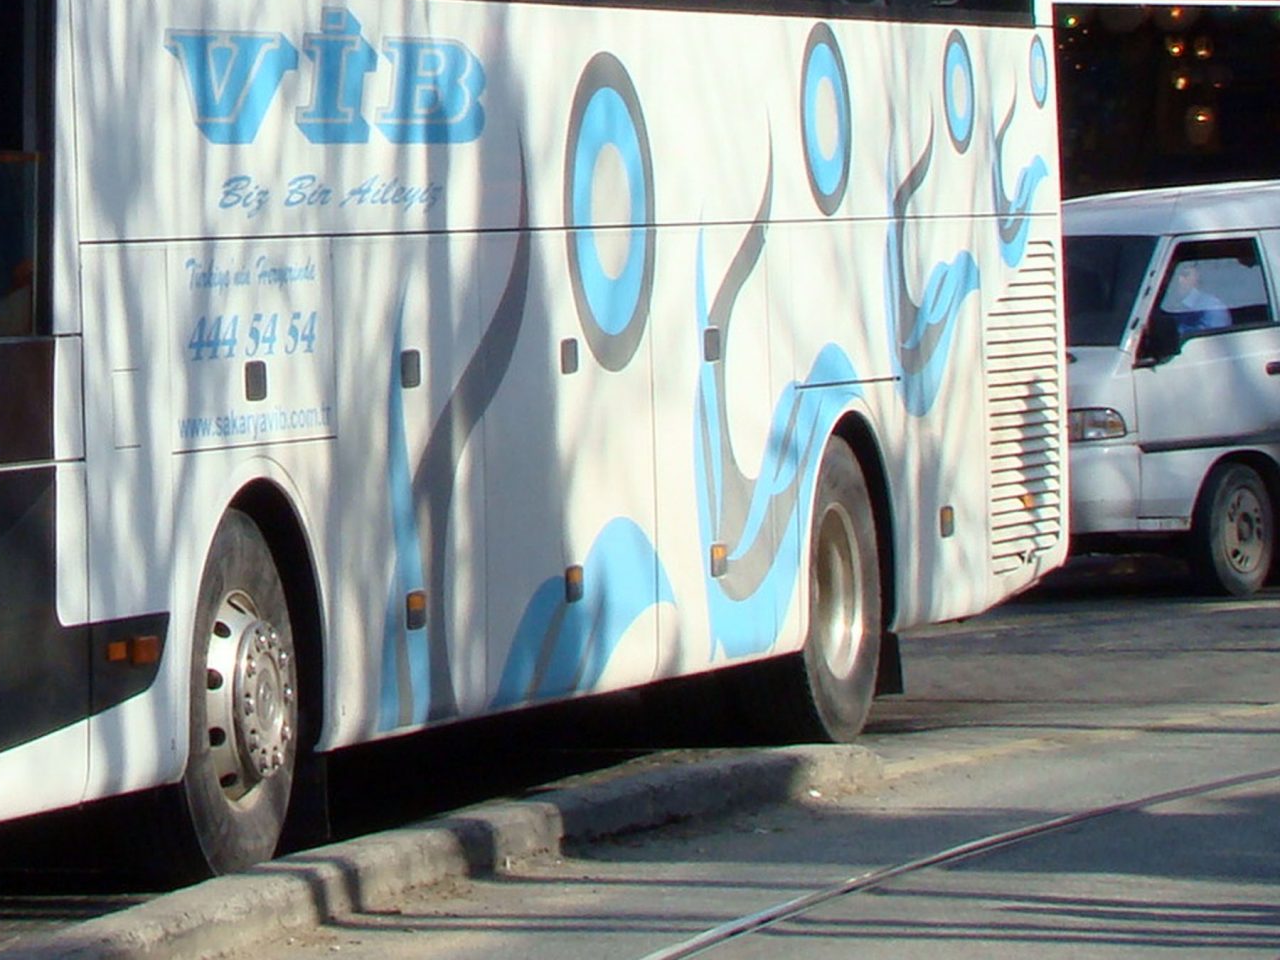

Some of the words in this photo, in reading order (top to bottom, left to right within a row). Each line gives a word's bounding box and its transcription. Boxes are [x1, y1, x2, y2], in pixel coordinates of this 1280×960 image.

[164, 5, 488, 145] VİB
[218, 175, 270, 219] Biz
[283, 174, 332, 208] Bir
[188, 315, 239, 361] 444
[245, 313, 278, 357] 54
[284, 311, 318, 355] 54
[178, 401, 332, 440] www.sakaryavib.com.tr
